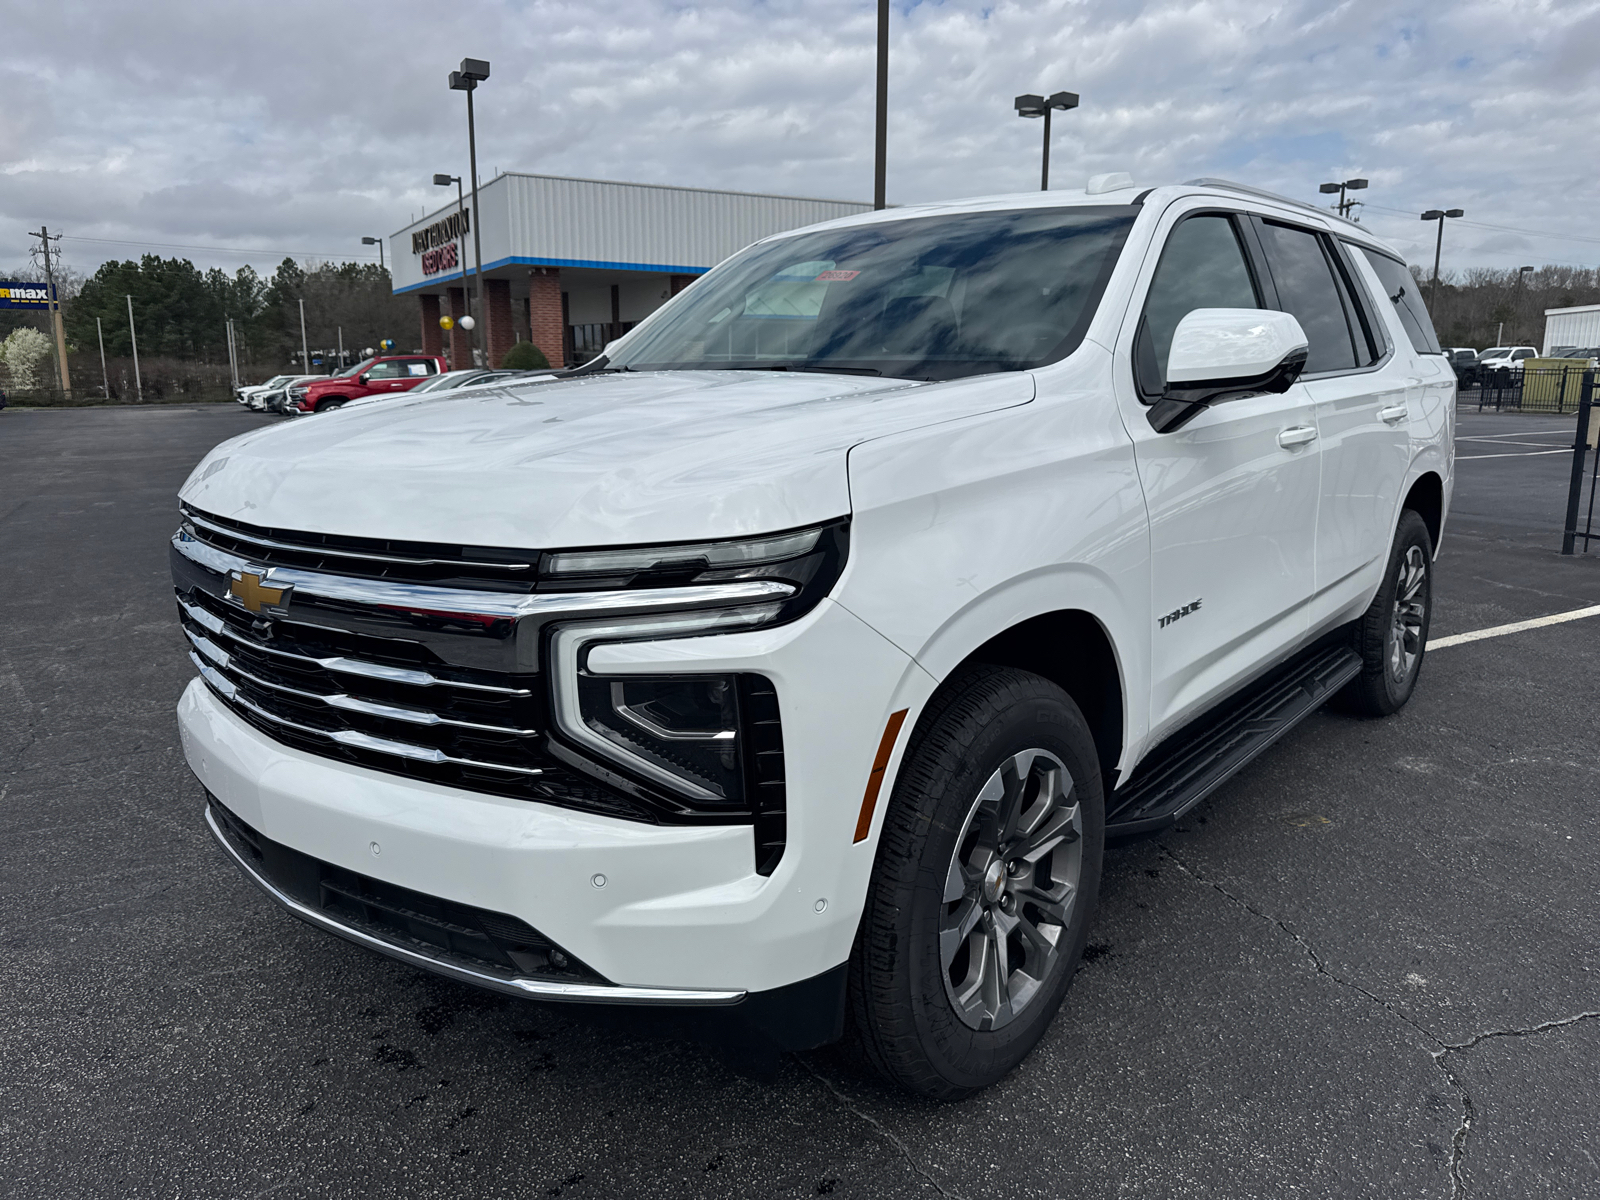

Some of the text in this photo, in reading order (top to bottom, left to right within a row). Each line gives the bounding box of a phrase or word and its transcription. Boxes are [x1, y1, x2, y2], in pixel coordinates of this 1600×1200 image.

[422, 243, 458, 275] USED CARS
[0, 288, 48, 299] Rmax
[1157, 598, 1203, 629] TAHOE
